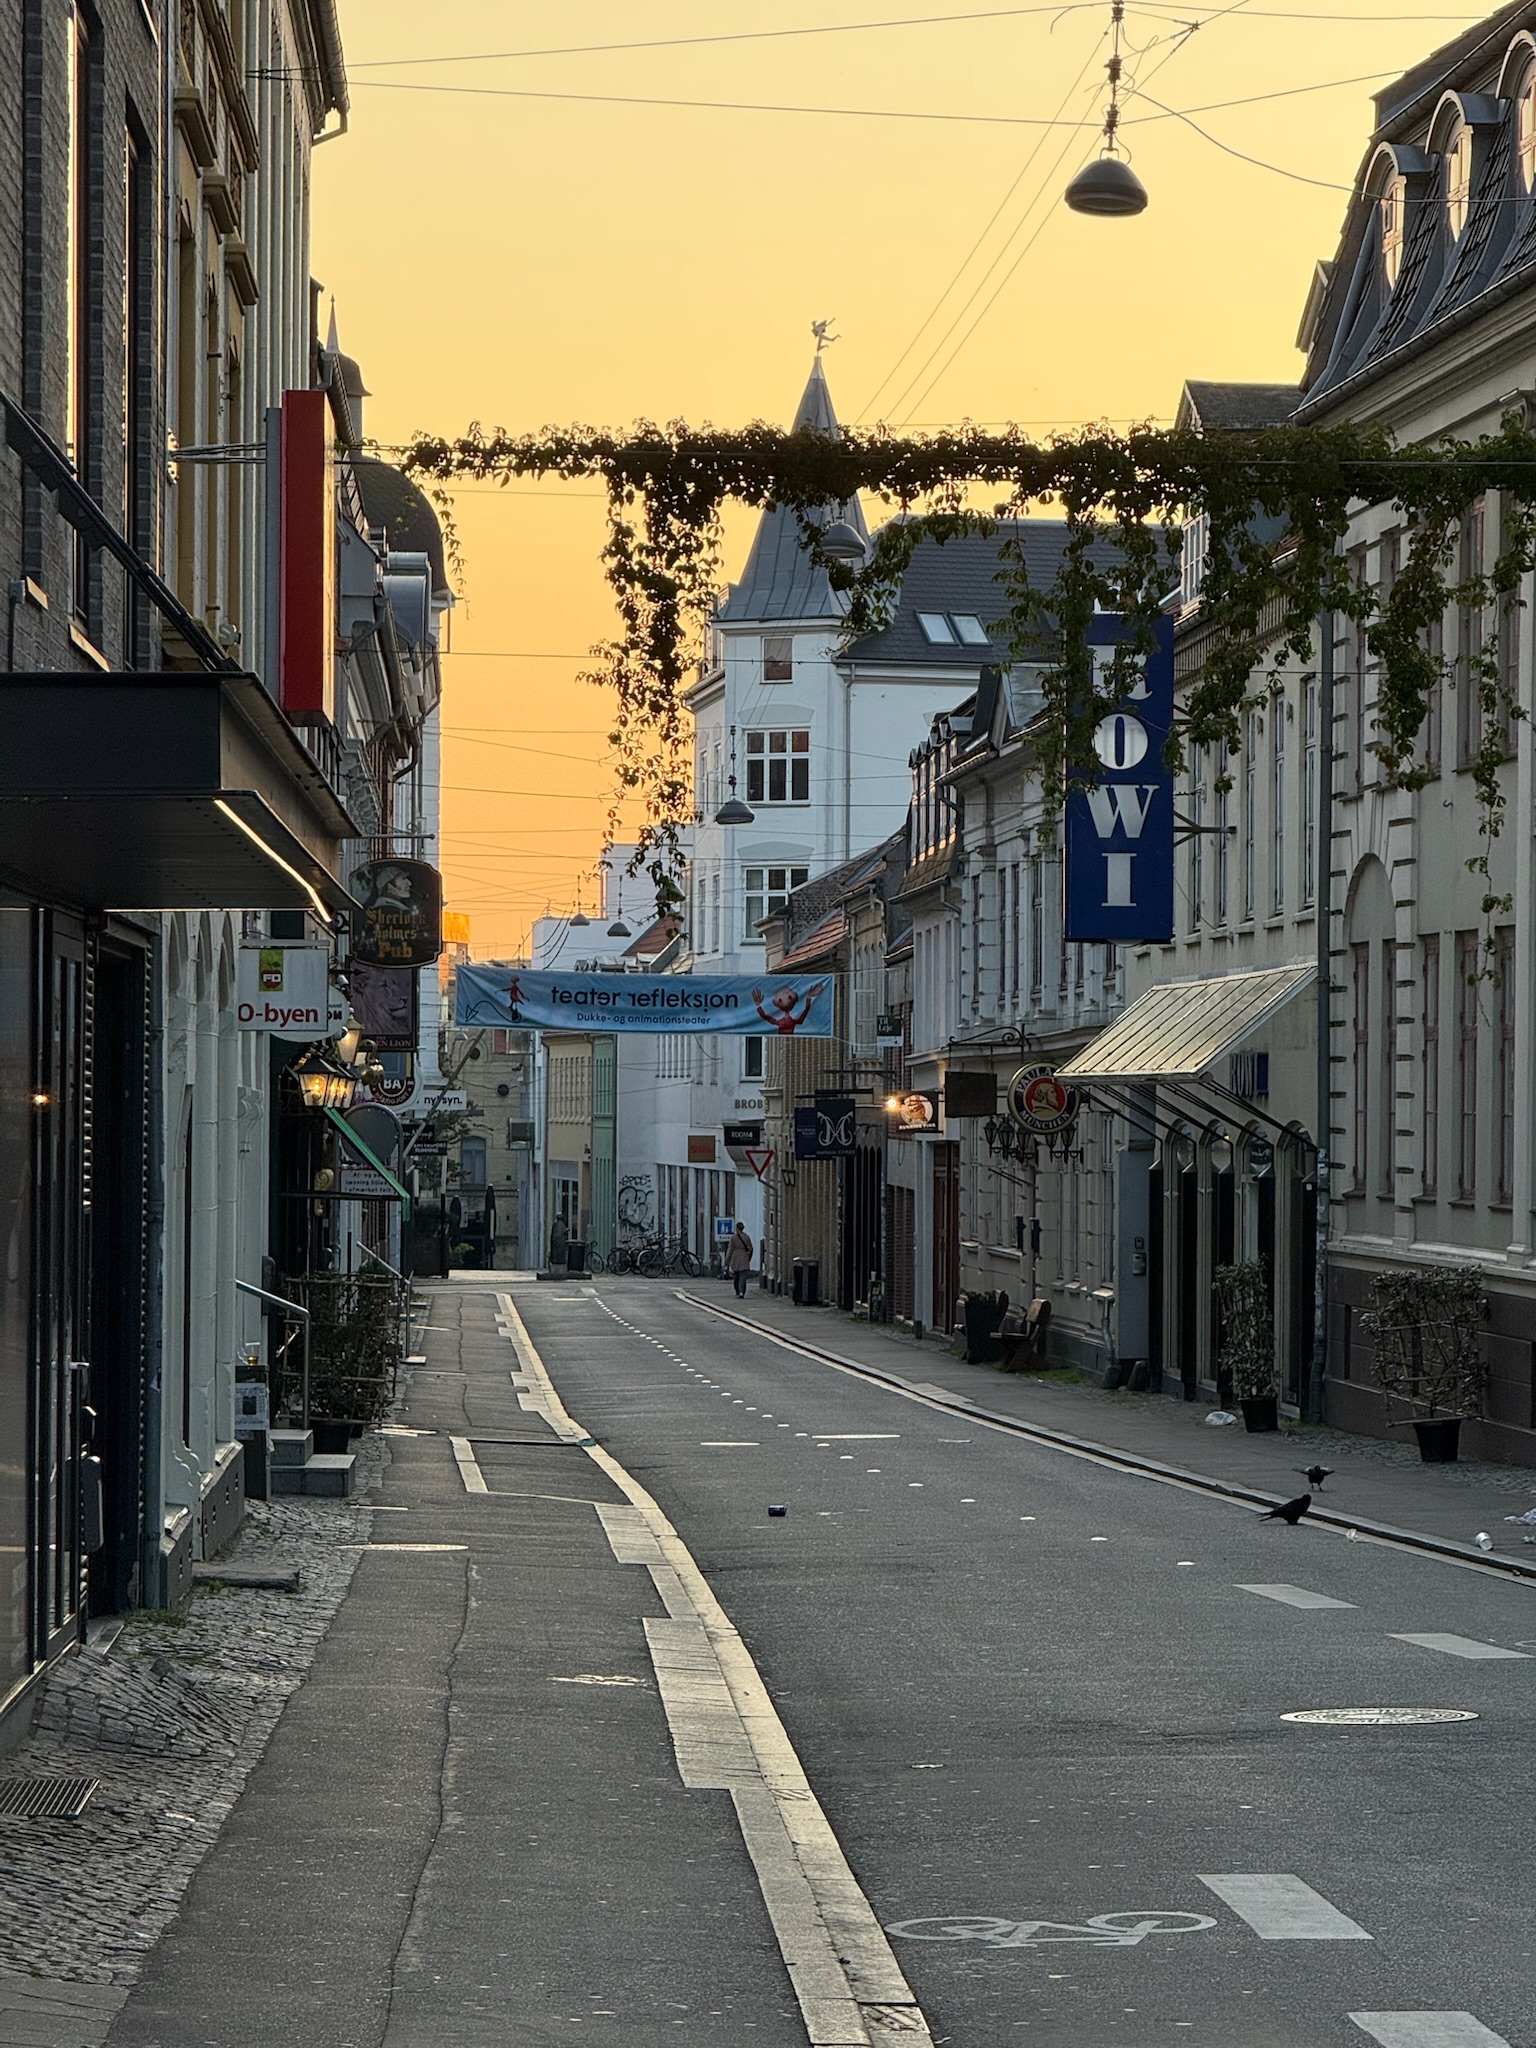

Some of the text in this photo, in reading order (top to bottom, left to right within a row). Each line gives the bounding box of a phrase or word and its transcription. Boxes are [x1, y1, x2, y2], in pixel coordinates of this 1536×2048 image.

[378, 941, 413, 958] Pub
[551, 986, 738, 1012] teater refleksion
[577, 1013, 710, 1024] Dukke- og animationsteater
[389, 1039, 411, 1047] LION
[1016, 1066, 1074, 1093] PAULAR
